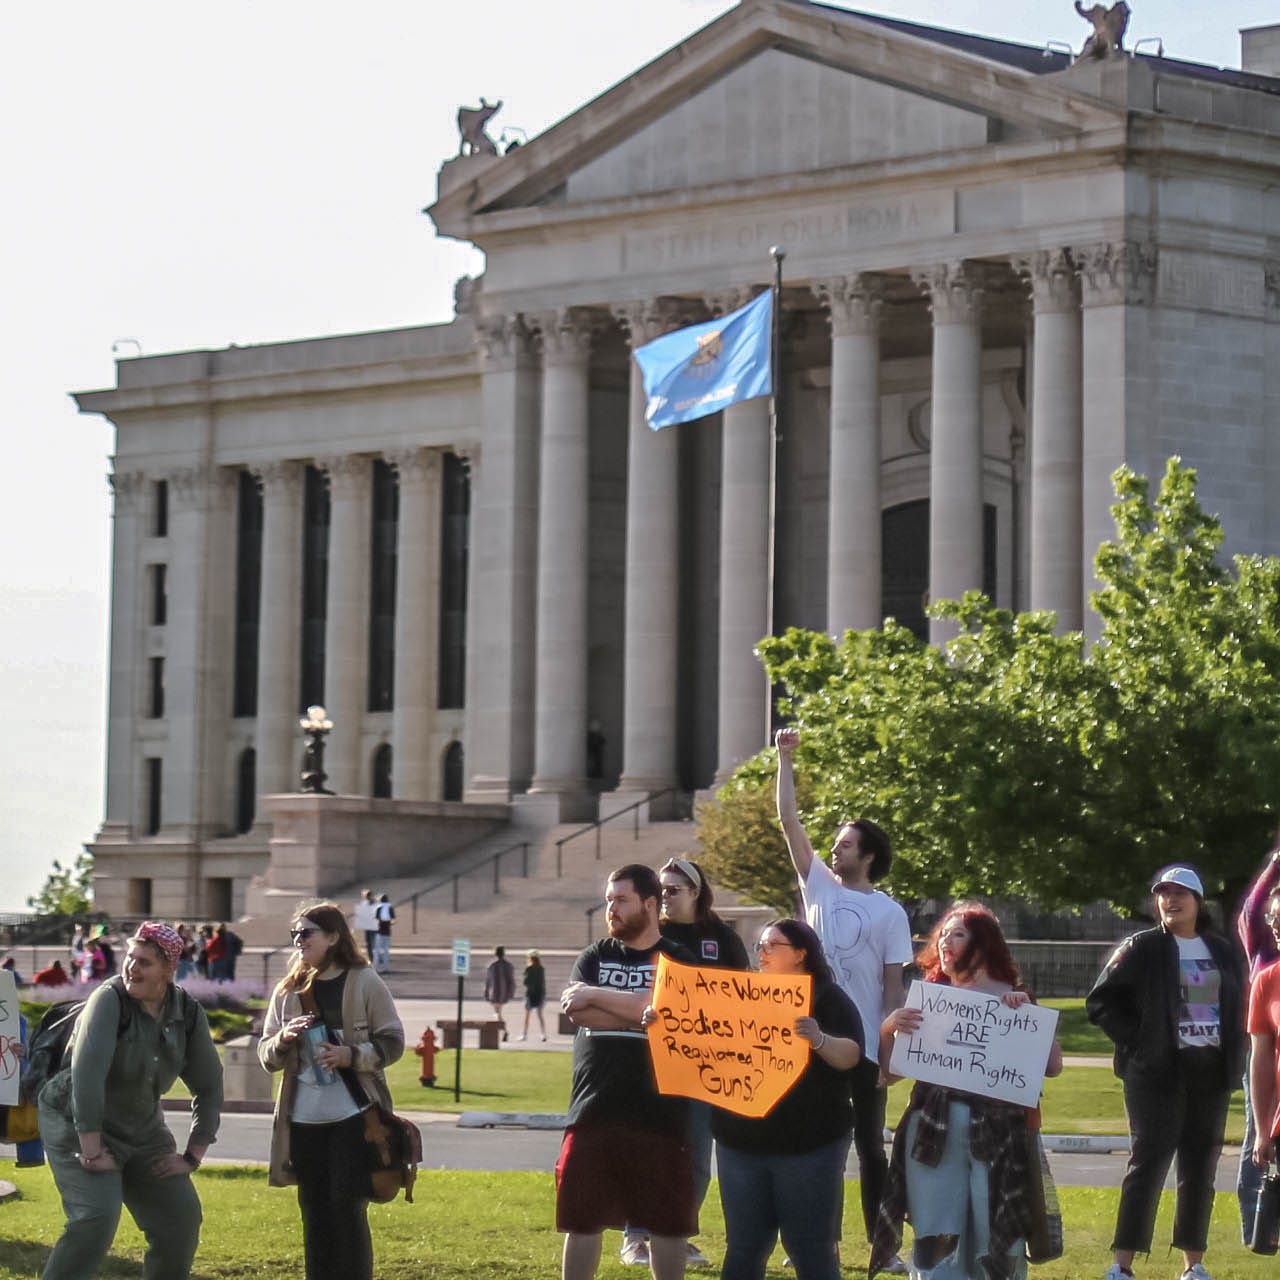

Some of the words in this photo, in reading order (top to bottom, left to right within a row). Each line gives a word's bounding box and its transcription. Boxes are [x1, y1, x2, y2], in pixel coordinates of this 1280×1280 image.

[695, 971, 732, 997] Are
[659, 1007, 734, 1038] Bodies
[739, 1019, 793, 1045] More
[950, 1022, 992, 1044] ARE
[752, 1045, 794, 1073] Than
[699, 1063, 765, 1103] Guns?
